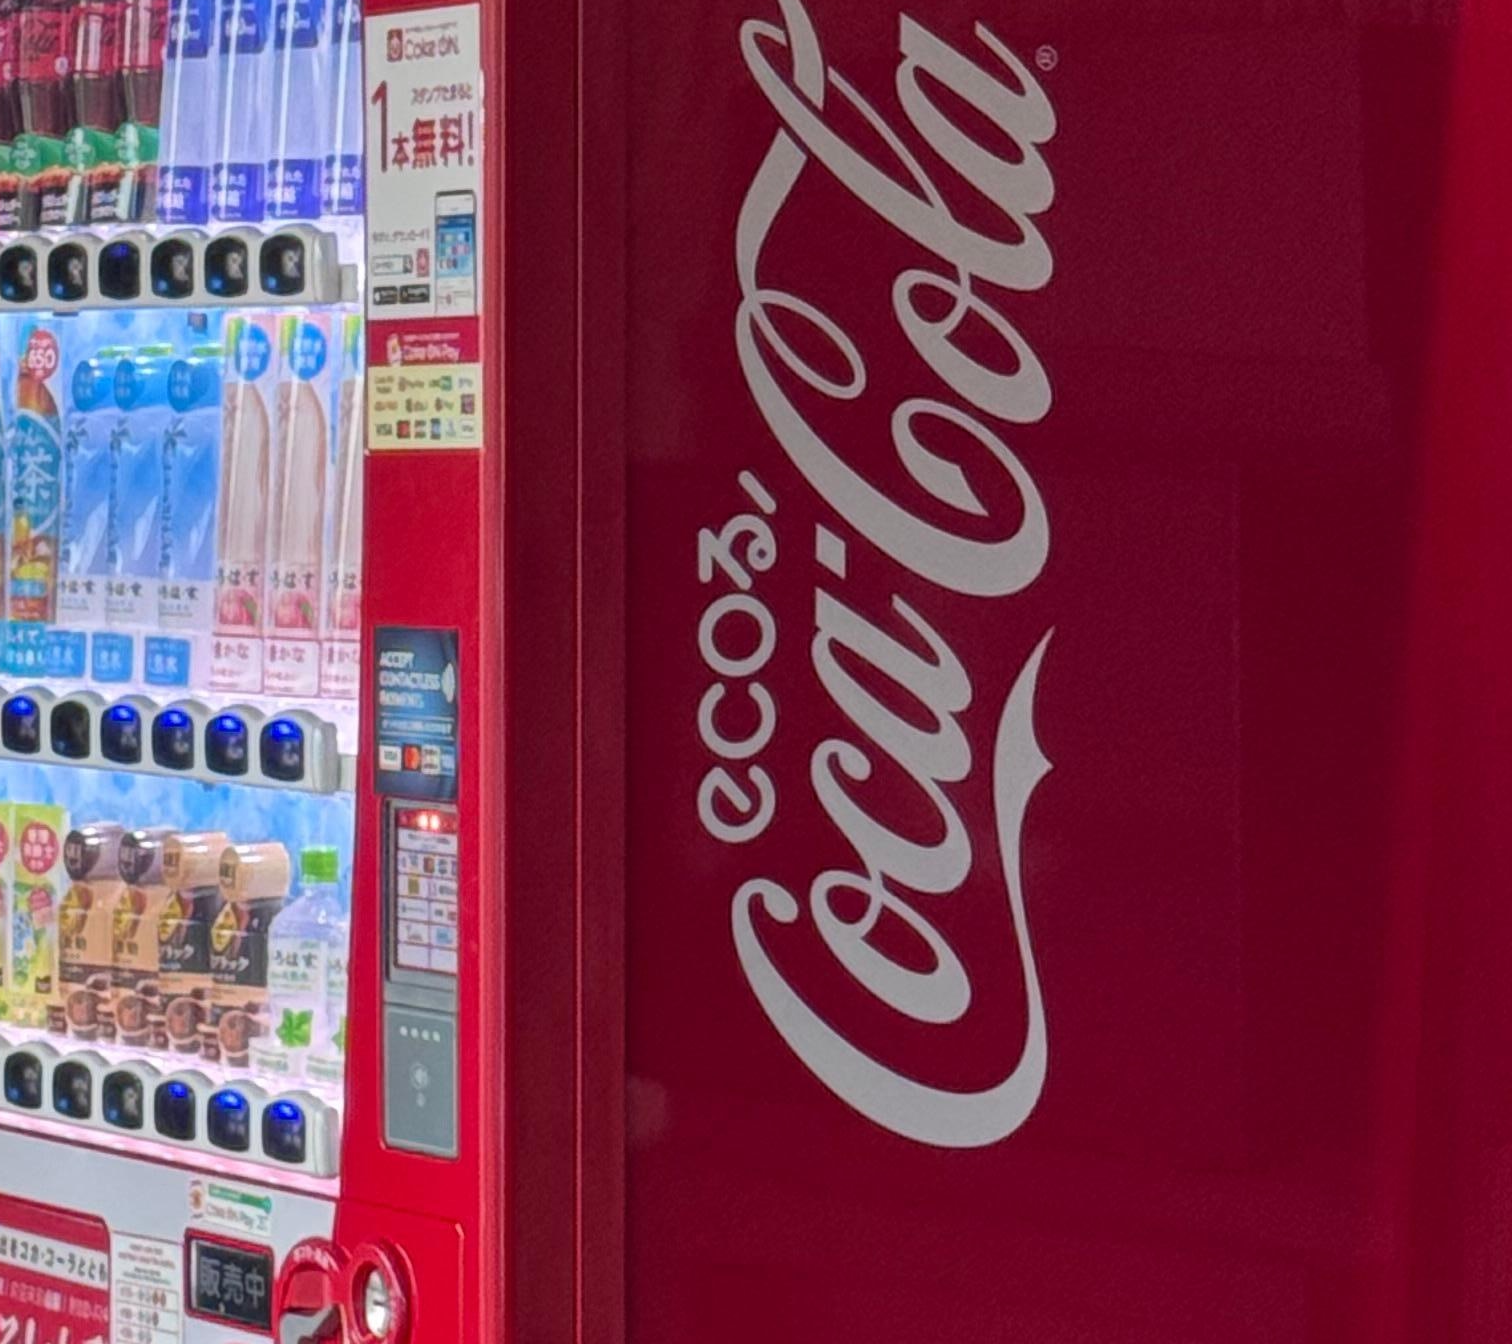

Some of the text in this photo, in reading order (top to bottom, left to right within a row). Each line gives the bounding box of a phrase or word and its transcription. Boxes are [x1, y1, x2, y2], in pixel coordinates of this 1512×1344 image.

[404, 33, 460, 61] Coke ON
[199, 1256, 267, 1308] 販売中
